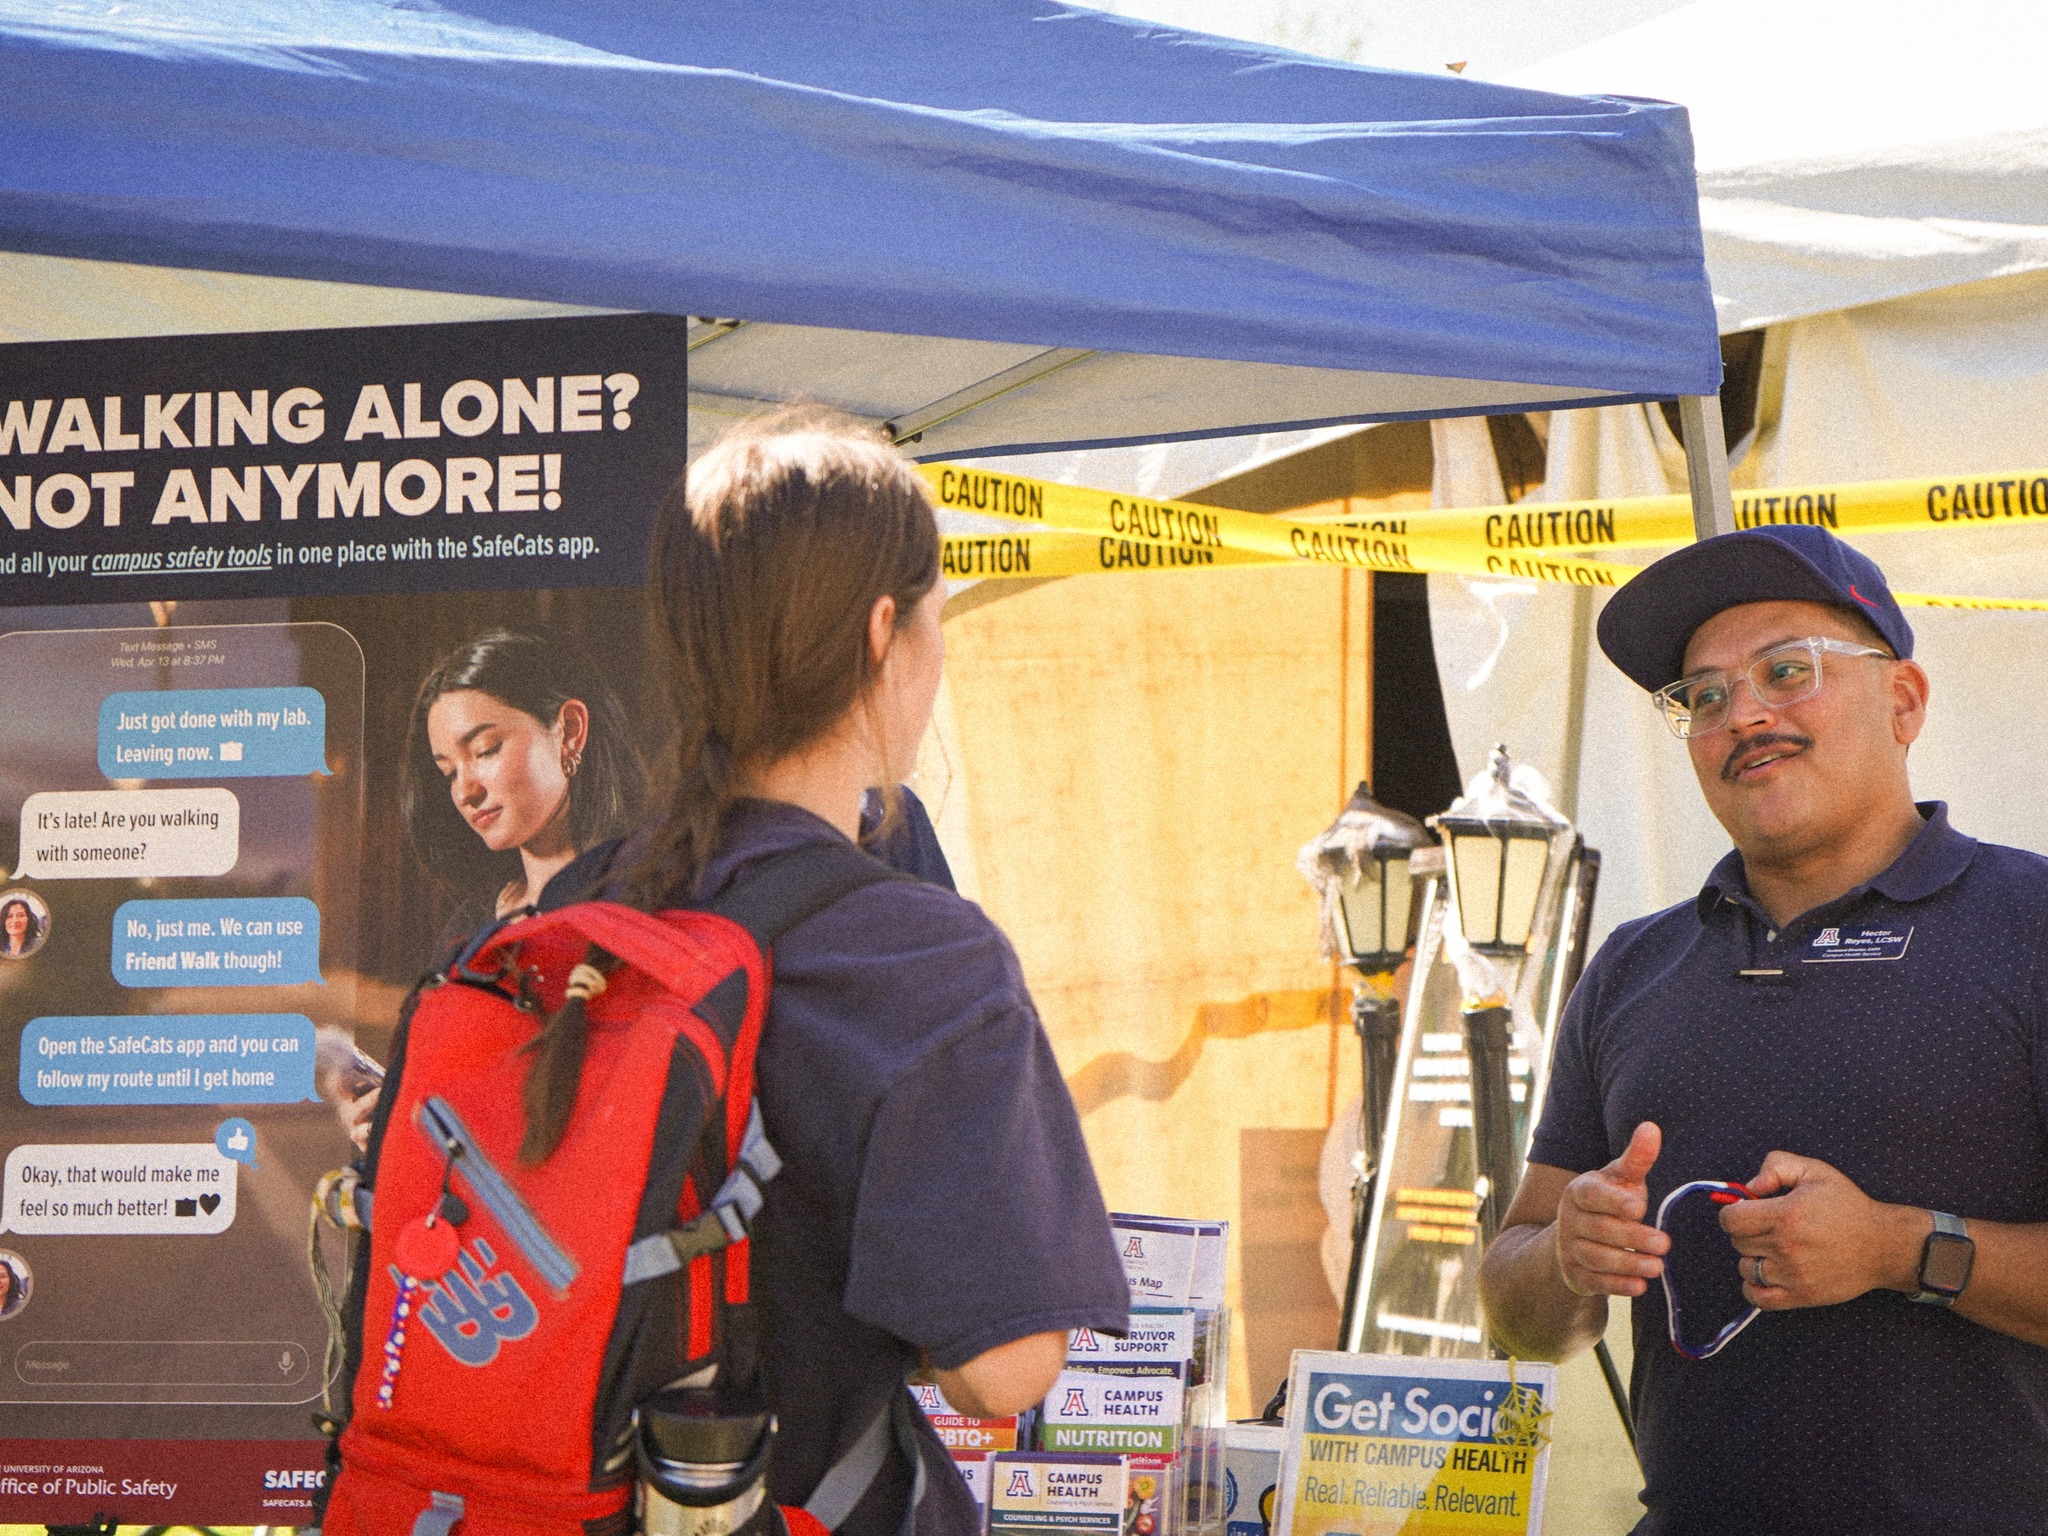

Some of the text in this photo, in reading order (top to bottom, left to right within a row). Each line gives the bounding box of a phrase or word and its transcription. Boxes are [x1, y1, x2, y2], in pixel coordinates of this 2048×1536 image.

[0, 372, 640, 455] WALKING ALONE?
[0, 453, 562, 530] NOT ANYMORE!
[941, 470, 1043, 518] CAUTION
[1733, 493, 1838, 530] UTION
[1110, 499, 1222, 547] CAUTION
[1486, 508, 1616, 548] CAUTION
[21, 552, 43, 573] all
[47, 554, 88, 578] your
[91, 551, 163, 574] campus
[166, 545, 223, 571] safety
[227, 543, 273, 566] tools
[277, 543, 293, 565] in
[299, 545, 333, 564] one
[337, 541, 387, 567] place
[391, 537, 432, 560] with
[437, 537, 467, 559] the
[472, 533, 554, 558] SafeCats
[558, 535, 600, 559] app.
[943, 538, 1030, 573] AUTION
[1291, 528, 1414, 569] CAUTION
[120, 639, 217, 653] Text Message SMS
[137, 657, 155, 669] Apr
[158, 656, 170, 667] 13
[207, 655, 225, 665] PM
[116, 708, 311, 734] Just got done with my lab.
[116, 744, 214, 766] Leaving now.
[64, 811, 97, 829] late!
[101, 811, 126, 828] Are
[129, 814, 157, 832] you
[160, 809, 219, 830] walking
[36, 843, 147, 862] with someone?
[127, 918, 303, 942] No, just me. We can use
[1875, 936, 1904, 944] LCSW
[126, 951, 282, 974] Friend Walk though!
[39, 1035, 299, 1059] Open the SafeCats app and you can
[37, 1067, 275, 1092] follow my route until I get home
[21, 1164, 220, 1187] Okay, that would make me
[20, 1197, 168, 1217] feel so much better!
[1139, 1277, 1163, 1289] Map
[1116, 1331, 1175, 1341] RVIVOR
[1114, 1342, 1168, 1353] SUPPORT
[1098, 1366, 1135, 1375] Empower.
[1137, 1366, 1174, 1375] Advocate.
[1104, 1390, 1164, 1402] CAMPUS
[1313, 1382, 1395, 1432] Get
[1104, 1404, 1159, 1416] HEALTH
[934, 1416, 981, 1427] GUIDE TO
[1056, 1429, 1163, 1448] NUTRITION
[1309, 1439, 1527, 1475] WITH CAMPUS HEALTH
[3, 1464, 51, 1474] UNIVERSITY
[53, 1465, 64, 1474] OF
[66, 1465, 104, 1474] ARIZONA
[1047, 1472, 1103, 1485] CAMPUS
[42, 1478, 61, 1495] of
[65, 1478, 117, 1495] Public
[121, 1478, 177, 1500] Safety
[1047, 1486, 1099, 1498] HEALTH
[1304, 1476, 1520, 1517] Real. Reliable. Relevant.
[1003, 1513, 1112, 1525] COUNSELING & PSYCH SERVICES
